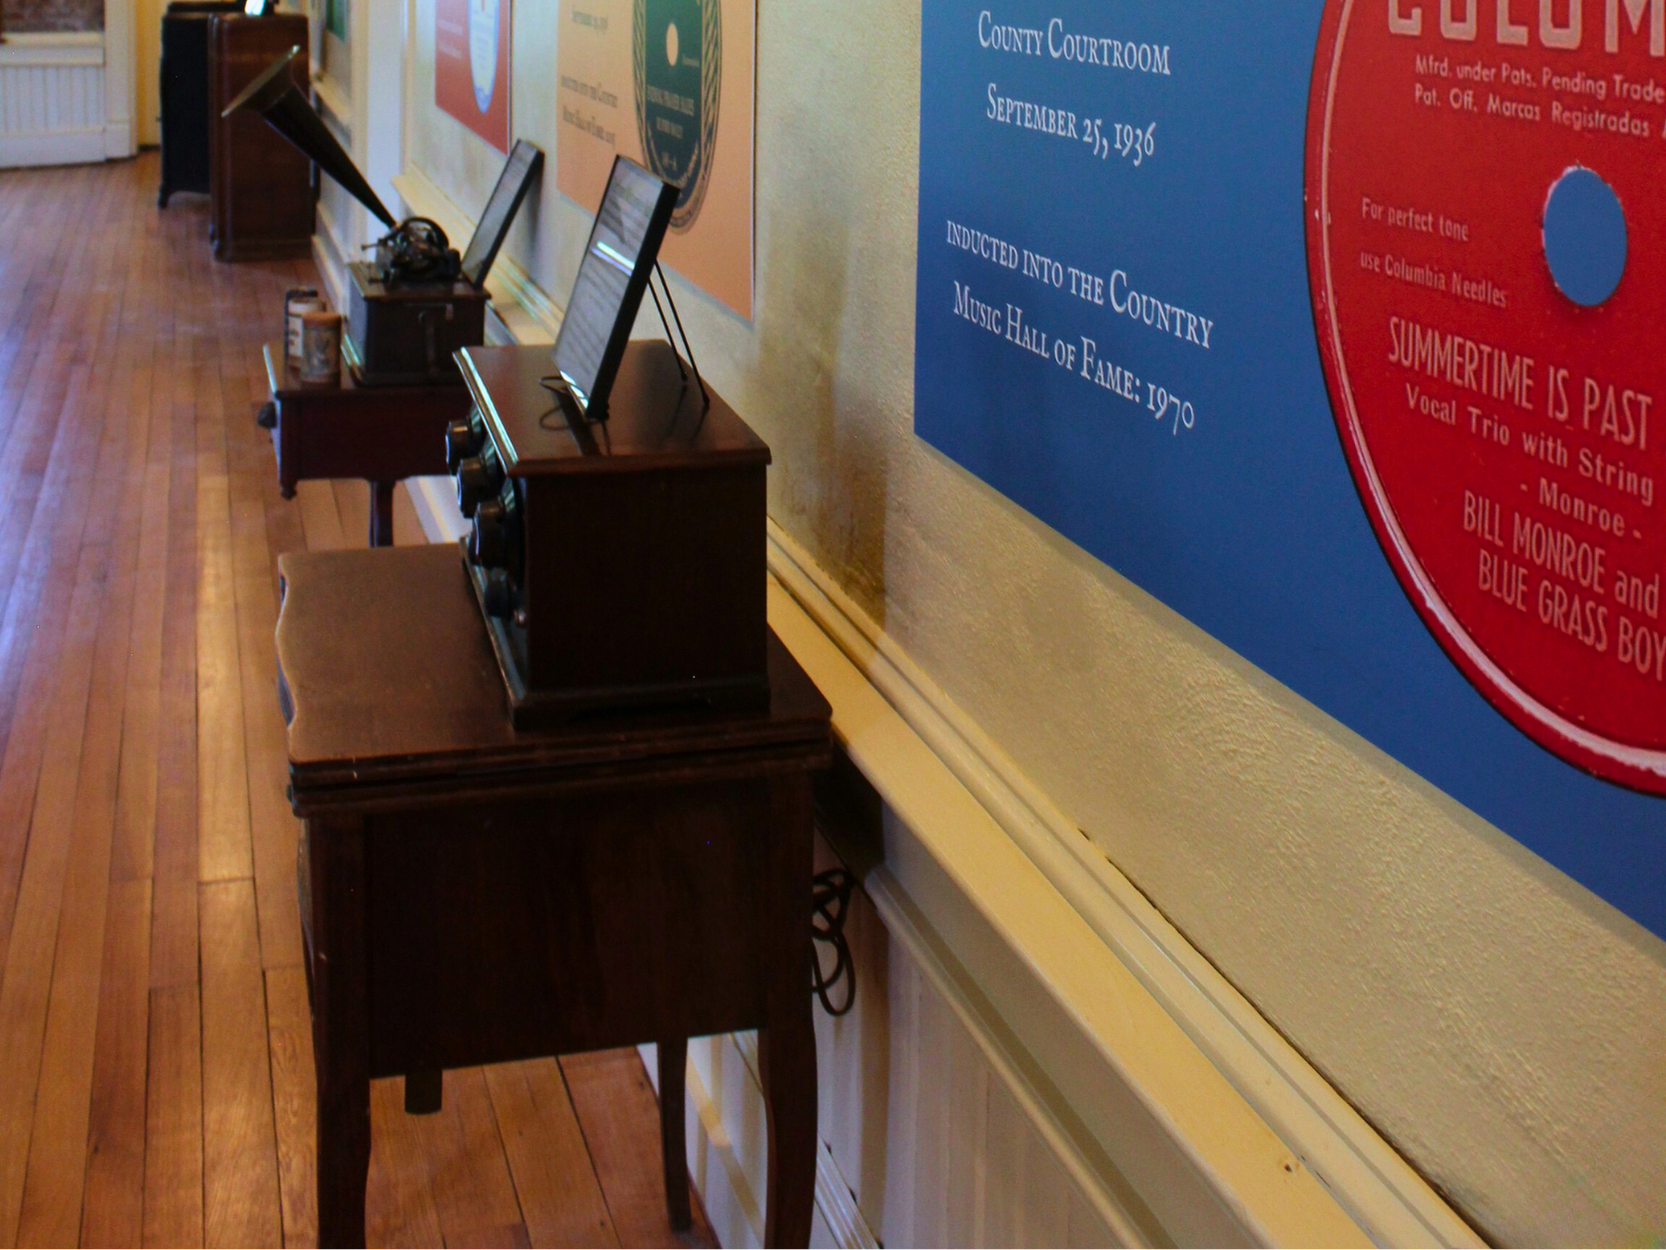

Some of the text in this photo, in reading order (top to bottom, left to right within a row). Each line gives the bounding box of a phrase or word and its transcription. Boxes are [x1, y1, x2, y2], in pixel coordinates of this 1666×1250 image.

[978, 10, 1171, 75] COUNTY COURTROOM
[1415, 54, 1665, 103] Mfrd. under Pats. Pending Trade
[987, 83, 1157, 167] SEPTEMBER 25, 1936
[1415, 83, 1440, 106] Pat.
[1450, 88, 1477, 112] Off.
[1487, 94, 1540, 121] Marcas
[1552, 101, 1649, 137] Registradas
[1362, 197, 1468, 241] For perfect tone
[946, 219, 1214, 349] INDUCTED INTO THE COUNTRY
[1360, 252, 1507, 308] use Columbia Needles
[953, 280, 1195, 436] MUSIC HALL OF FAME: 1970
[1388, 316, 1652, 450] SUMMERTIME IS PAST
[1406, 383, 1653, 506] Vocal Trio with String
[1539, 477, 1625, 537] Monroe
[1463, 490, 1659, 619] BILL MONROE and
[1478, 548, 1528, 612] BLUE
[1538, 579, 1607, 652] GRASS
